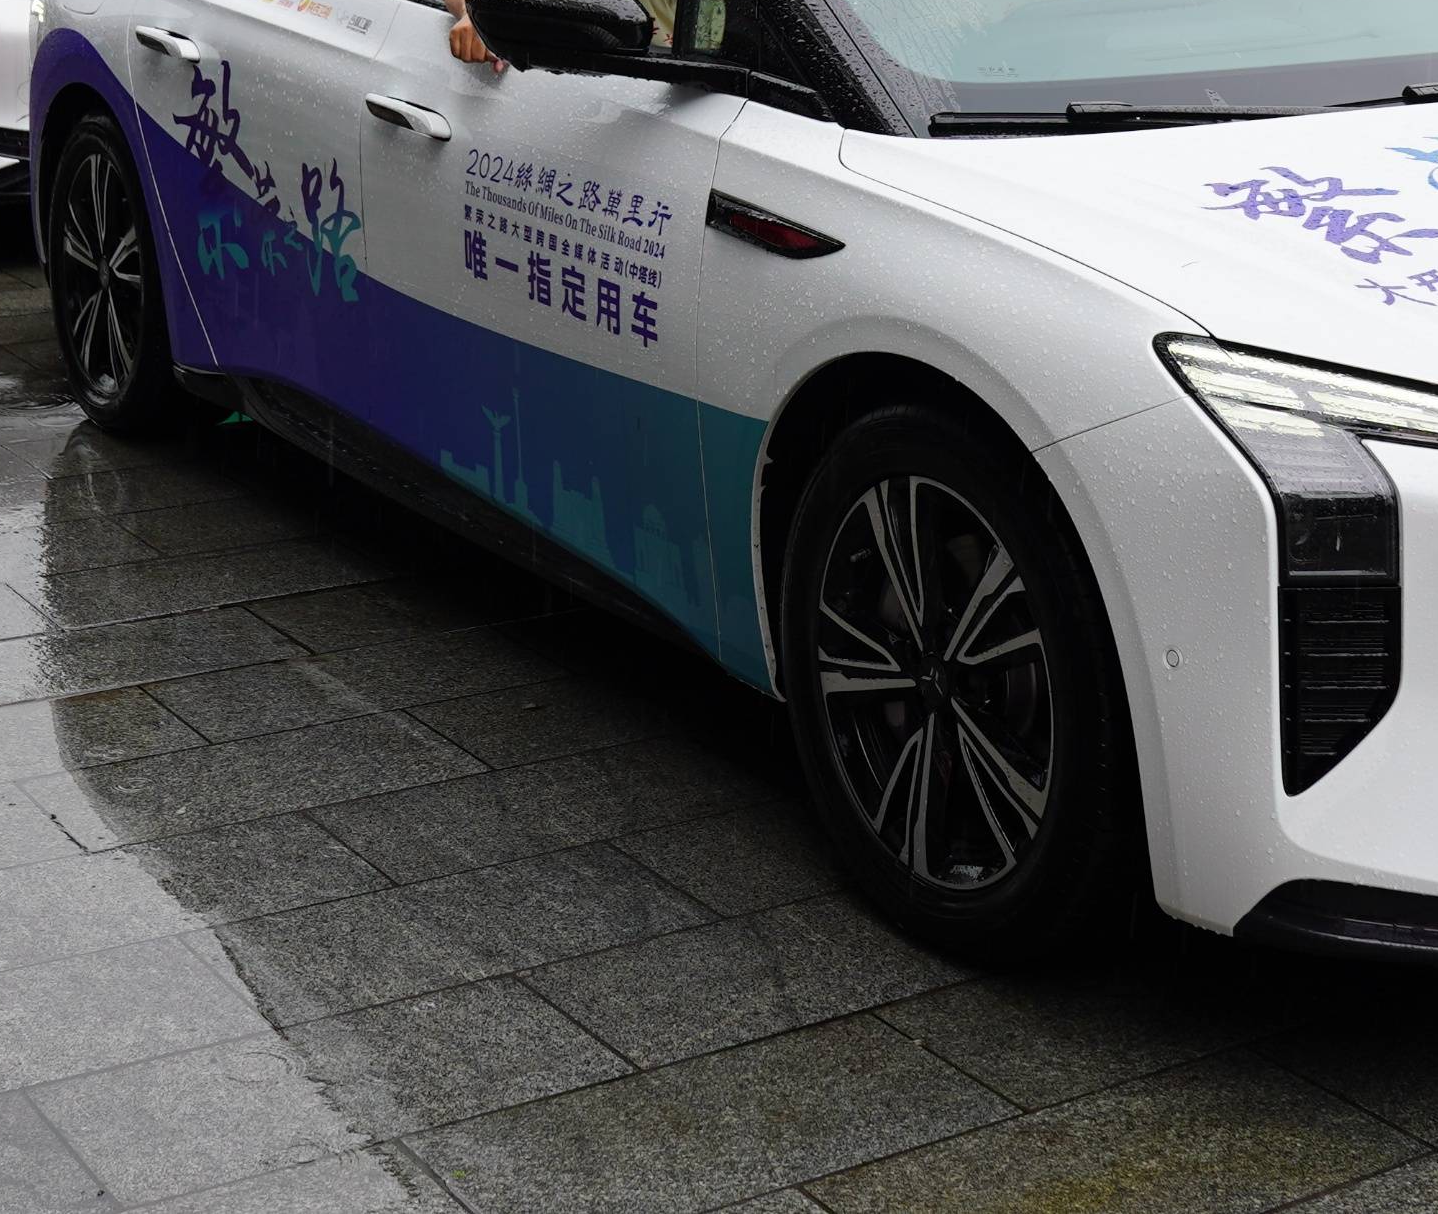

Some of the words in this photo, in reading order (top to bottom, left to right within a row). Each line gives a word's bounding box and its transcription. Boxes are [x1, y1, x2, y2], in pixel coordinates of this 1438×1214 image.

[465, 180, 481, 199] The
[482, 186, 528, 214] Thousands
[528, 202, 540, 217] Of
[539, 205, 564, 226] Miles
[565, 213, 578, 231] On
[579, 218, 597, 237] The
[597, 224, 616, 243] Silk
[617, 234, 642, 253] Road
[644, 239, 665, 260] 2024
[464, 229, 659, 348] 唯一指定用车
